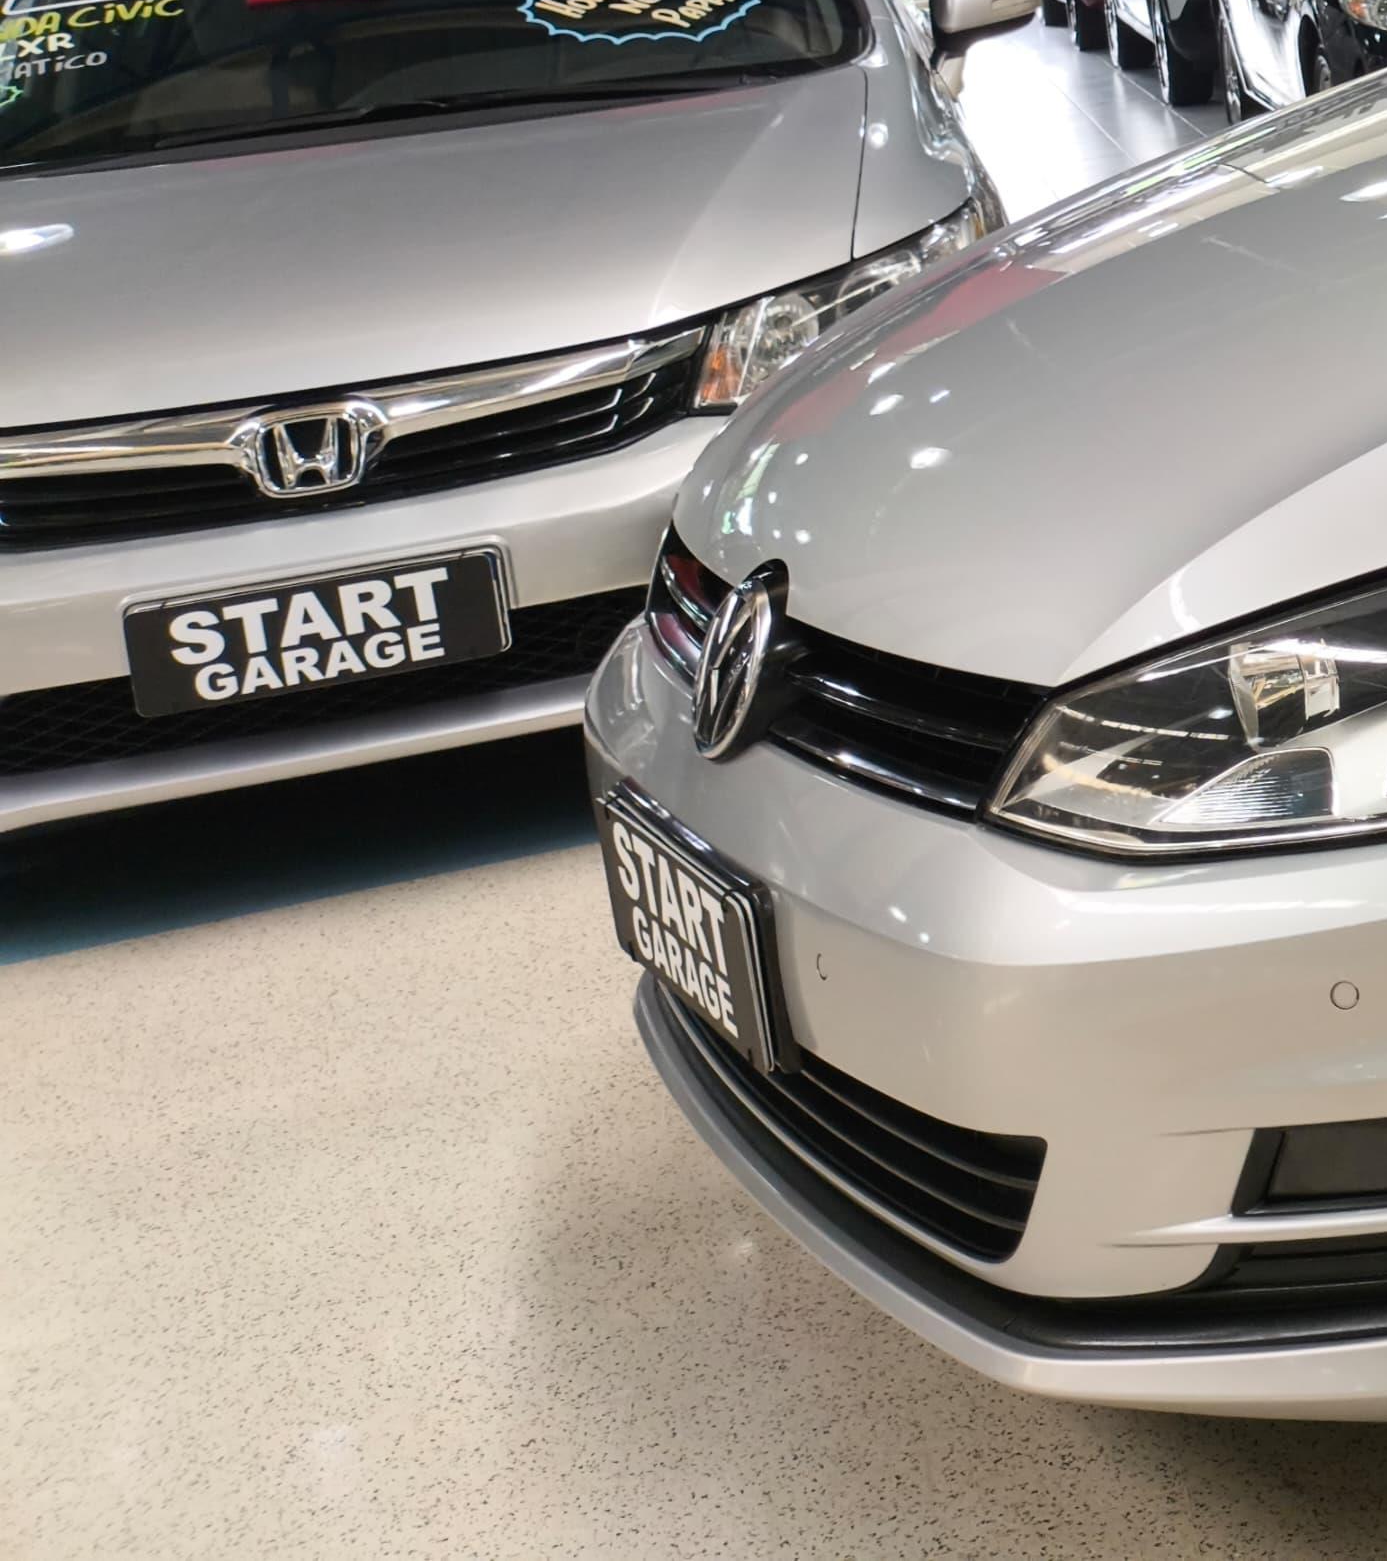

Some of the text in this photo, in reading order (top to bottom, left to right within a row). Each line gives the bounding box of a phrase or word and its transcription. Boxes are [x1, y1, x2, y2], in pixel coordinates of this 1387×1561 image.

[169, 567, 450, 666] START
[194, 622, 445, 702] GARAGE
[613, 821, 728, 977] START
[632, 906, 739, 1039] GARAGE
